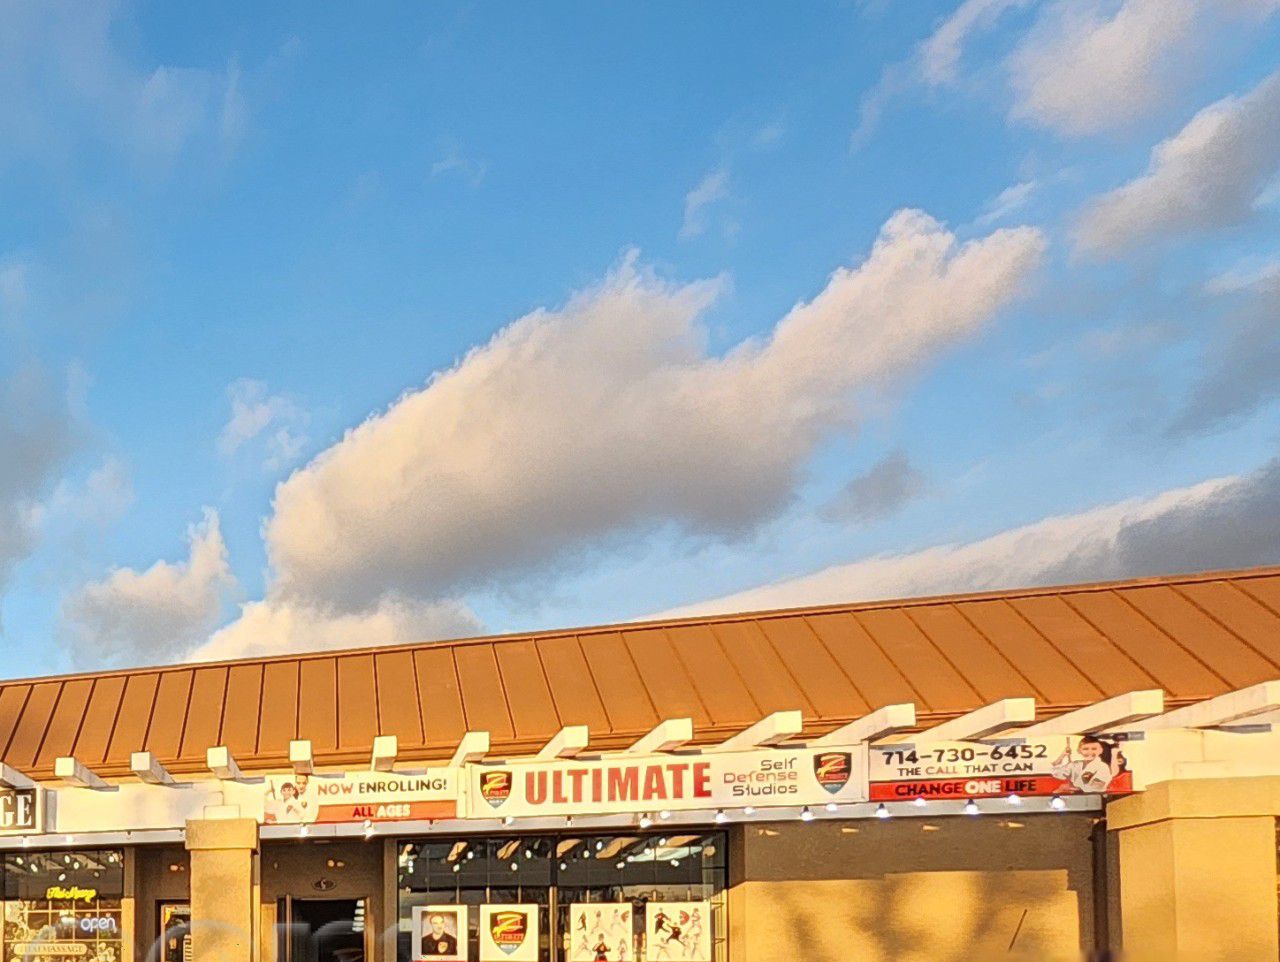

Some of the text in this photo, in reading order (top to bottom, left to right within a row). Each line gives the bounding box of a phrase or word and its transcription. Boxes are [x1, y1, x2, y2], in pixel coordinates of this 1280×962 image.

[882, 744, 1048, 766] 714-730-6452
[760, 757, 798, 772] Self
[896, 761, 1034, 777] THE CALL THAT CAN
[524, 761, 713, 806] ULTIMATE
[722, 769, 799, 784] Defense
[317, 778, 448, 796] NOW ENROLLING!
[732, 783, 799, 798] Studios
[894, 778, 1037, 797] CHANGE ONE LIFE
[352, 803, 411, 818] ALL AGES
